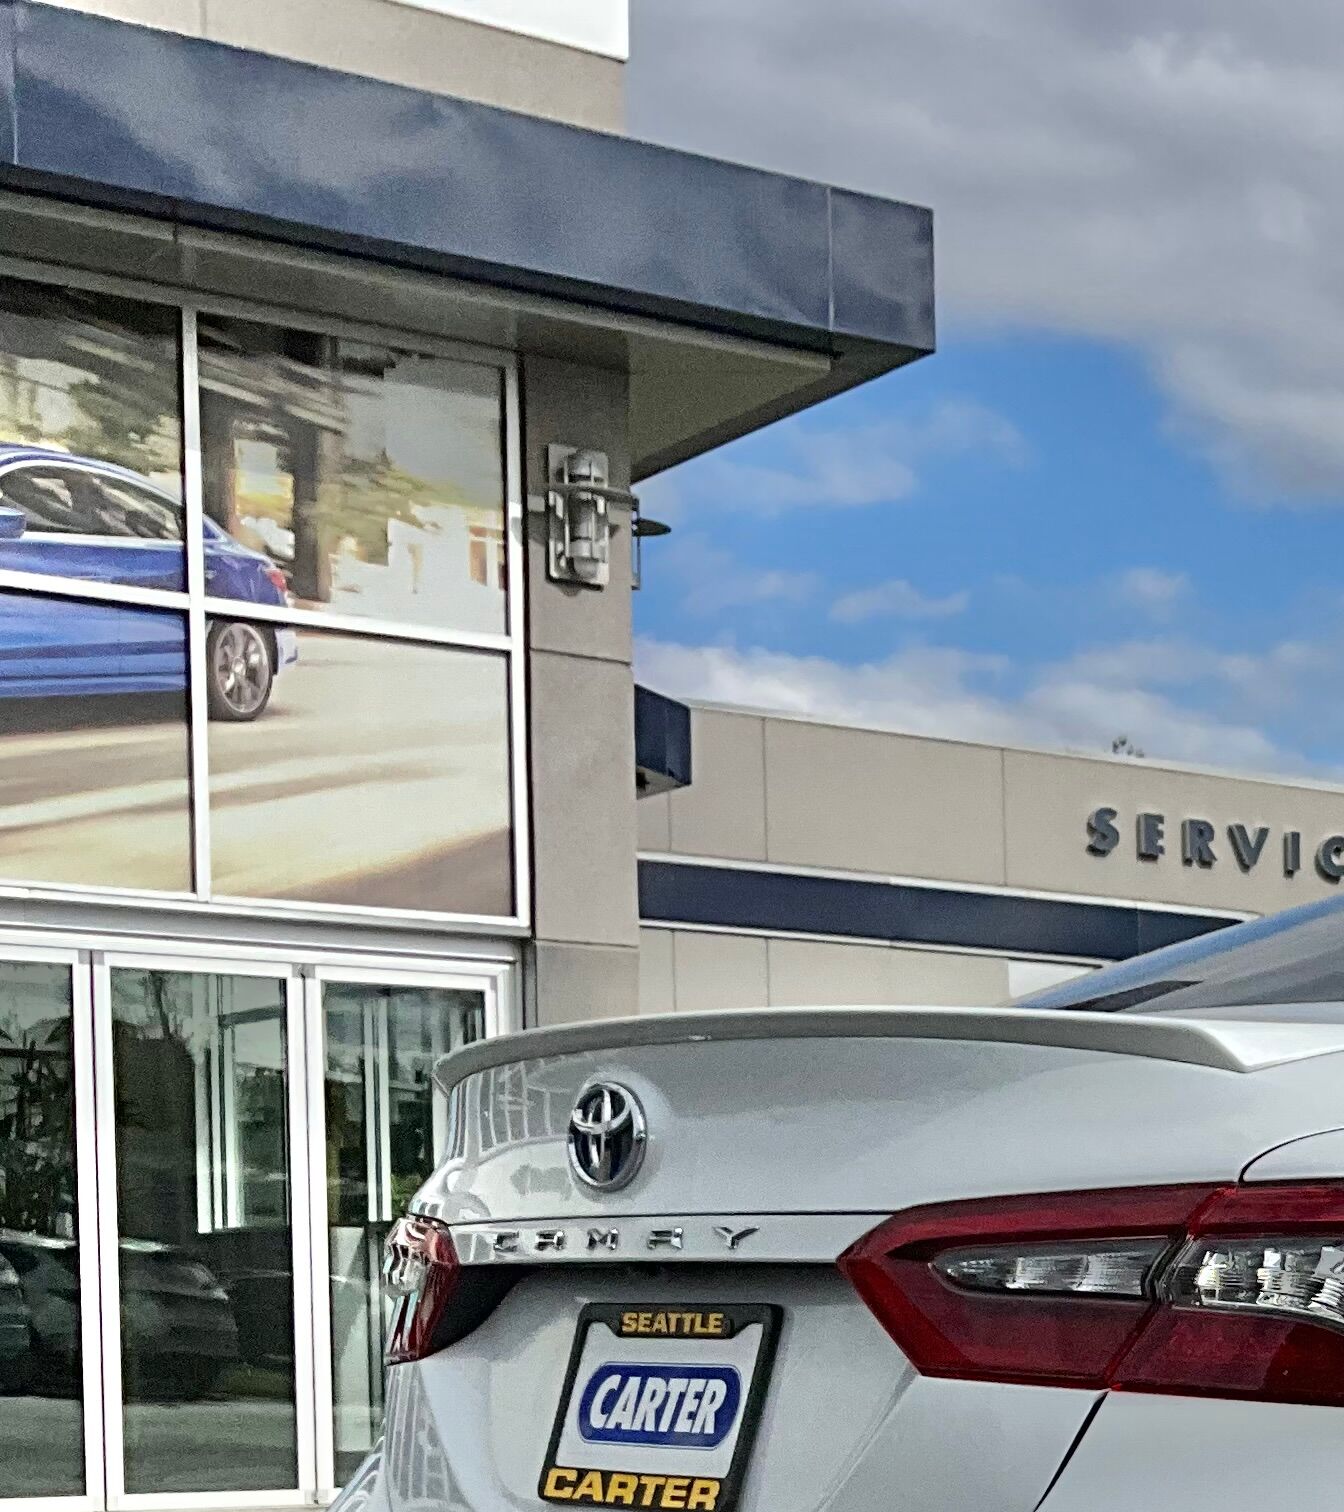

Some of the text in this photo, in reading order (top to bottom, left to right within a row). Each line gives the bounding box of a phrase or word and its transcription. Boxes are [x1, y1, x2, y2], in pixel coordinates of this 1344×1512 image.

[493, 1226, 760, 1250] CAMRY
[621, 1312, 725, 1335] SEATTLE
[589, 1374, 728, 1434] CARTER
[544, 1468, 721, 1511] CARTER
